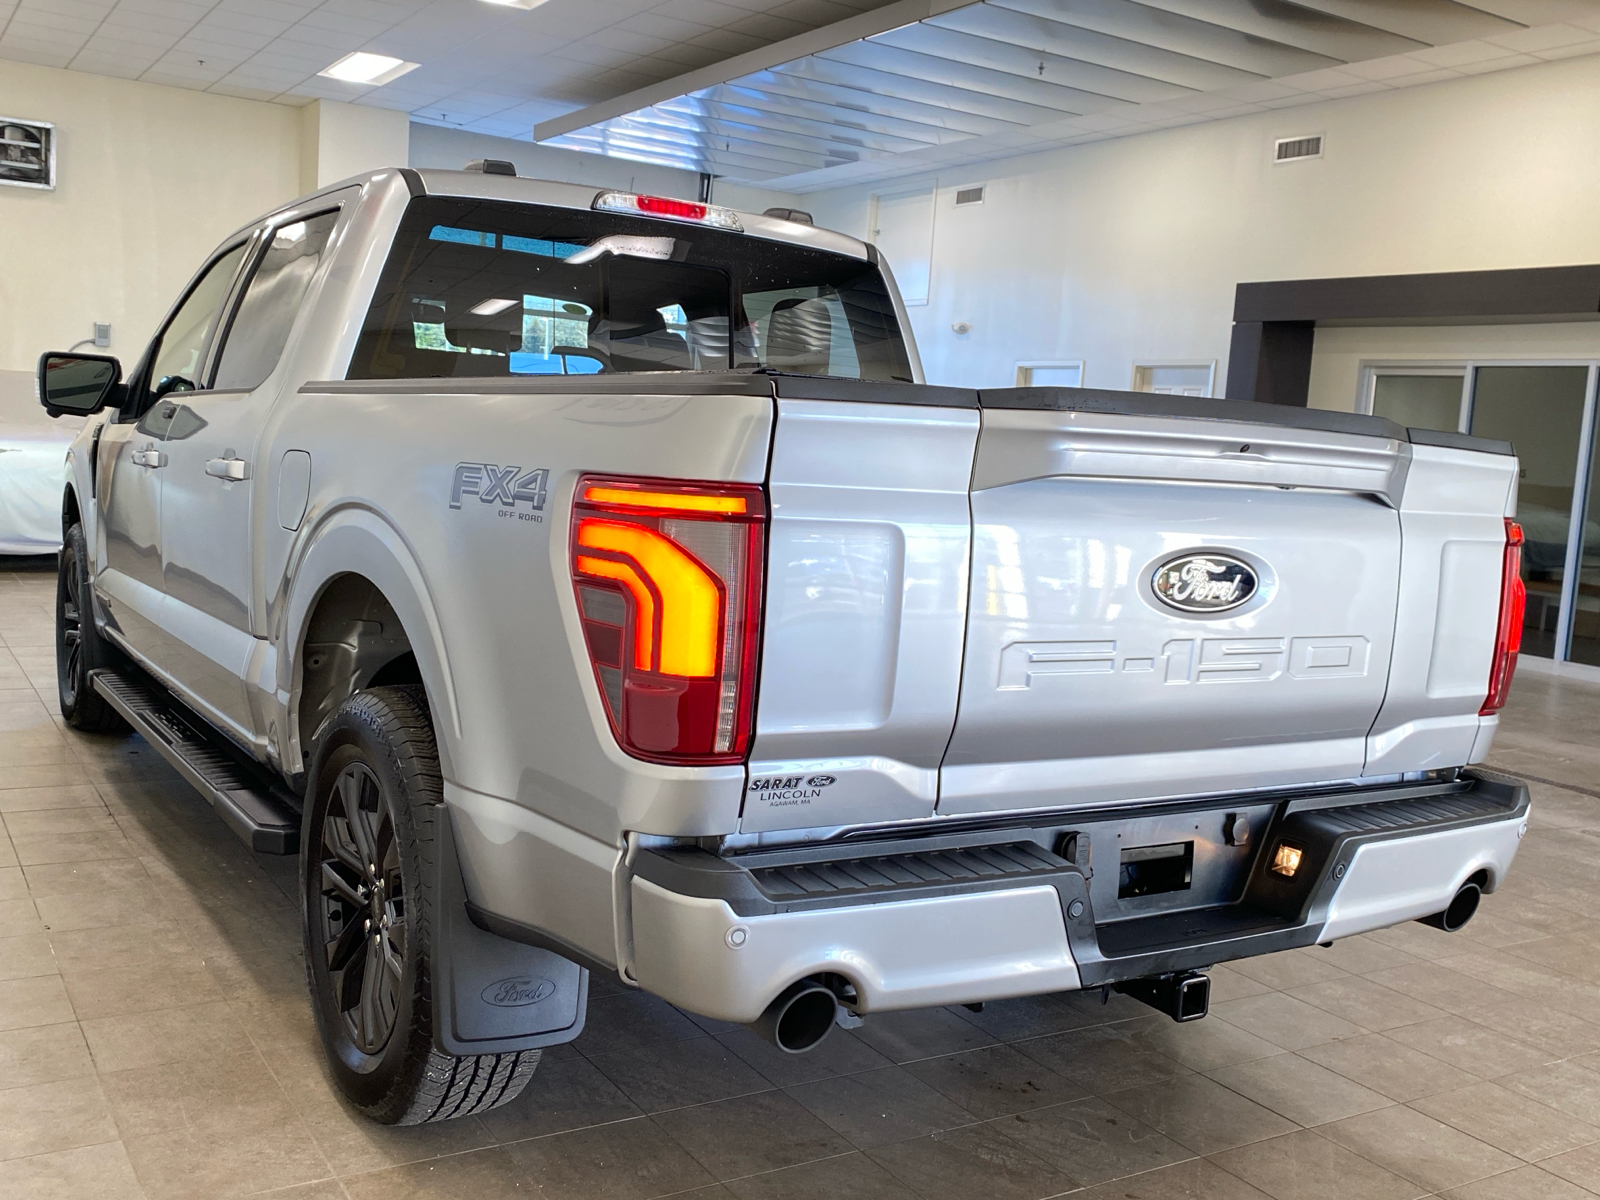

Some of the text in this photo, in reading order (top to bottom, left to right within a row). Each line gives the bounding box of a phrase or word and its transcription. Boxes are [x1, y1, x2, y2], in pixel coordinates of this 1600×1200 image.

[449, 461, 549, 511] FX4
[498, 510, 543, 523] OFF ROAD
[1173, 560, 1241, 601] Ford
[997, 635, 1371, 691] F-150
[749, 776, 804, 791] SARAT
[760, 789, 821, 801] LINCOLN
[494, 980, 543, 1003] Ford
